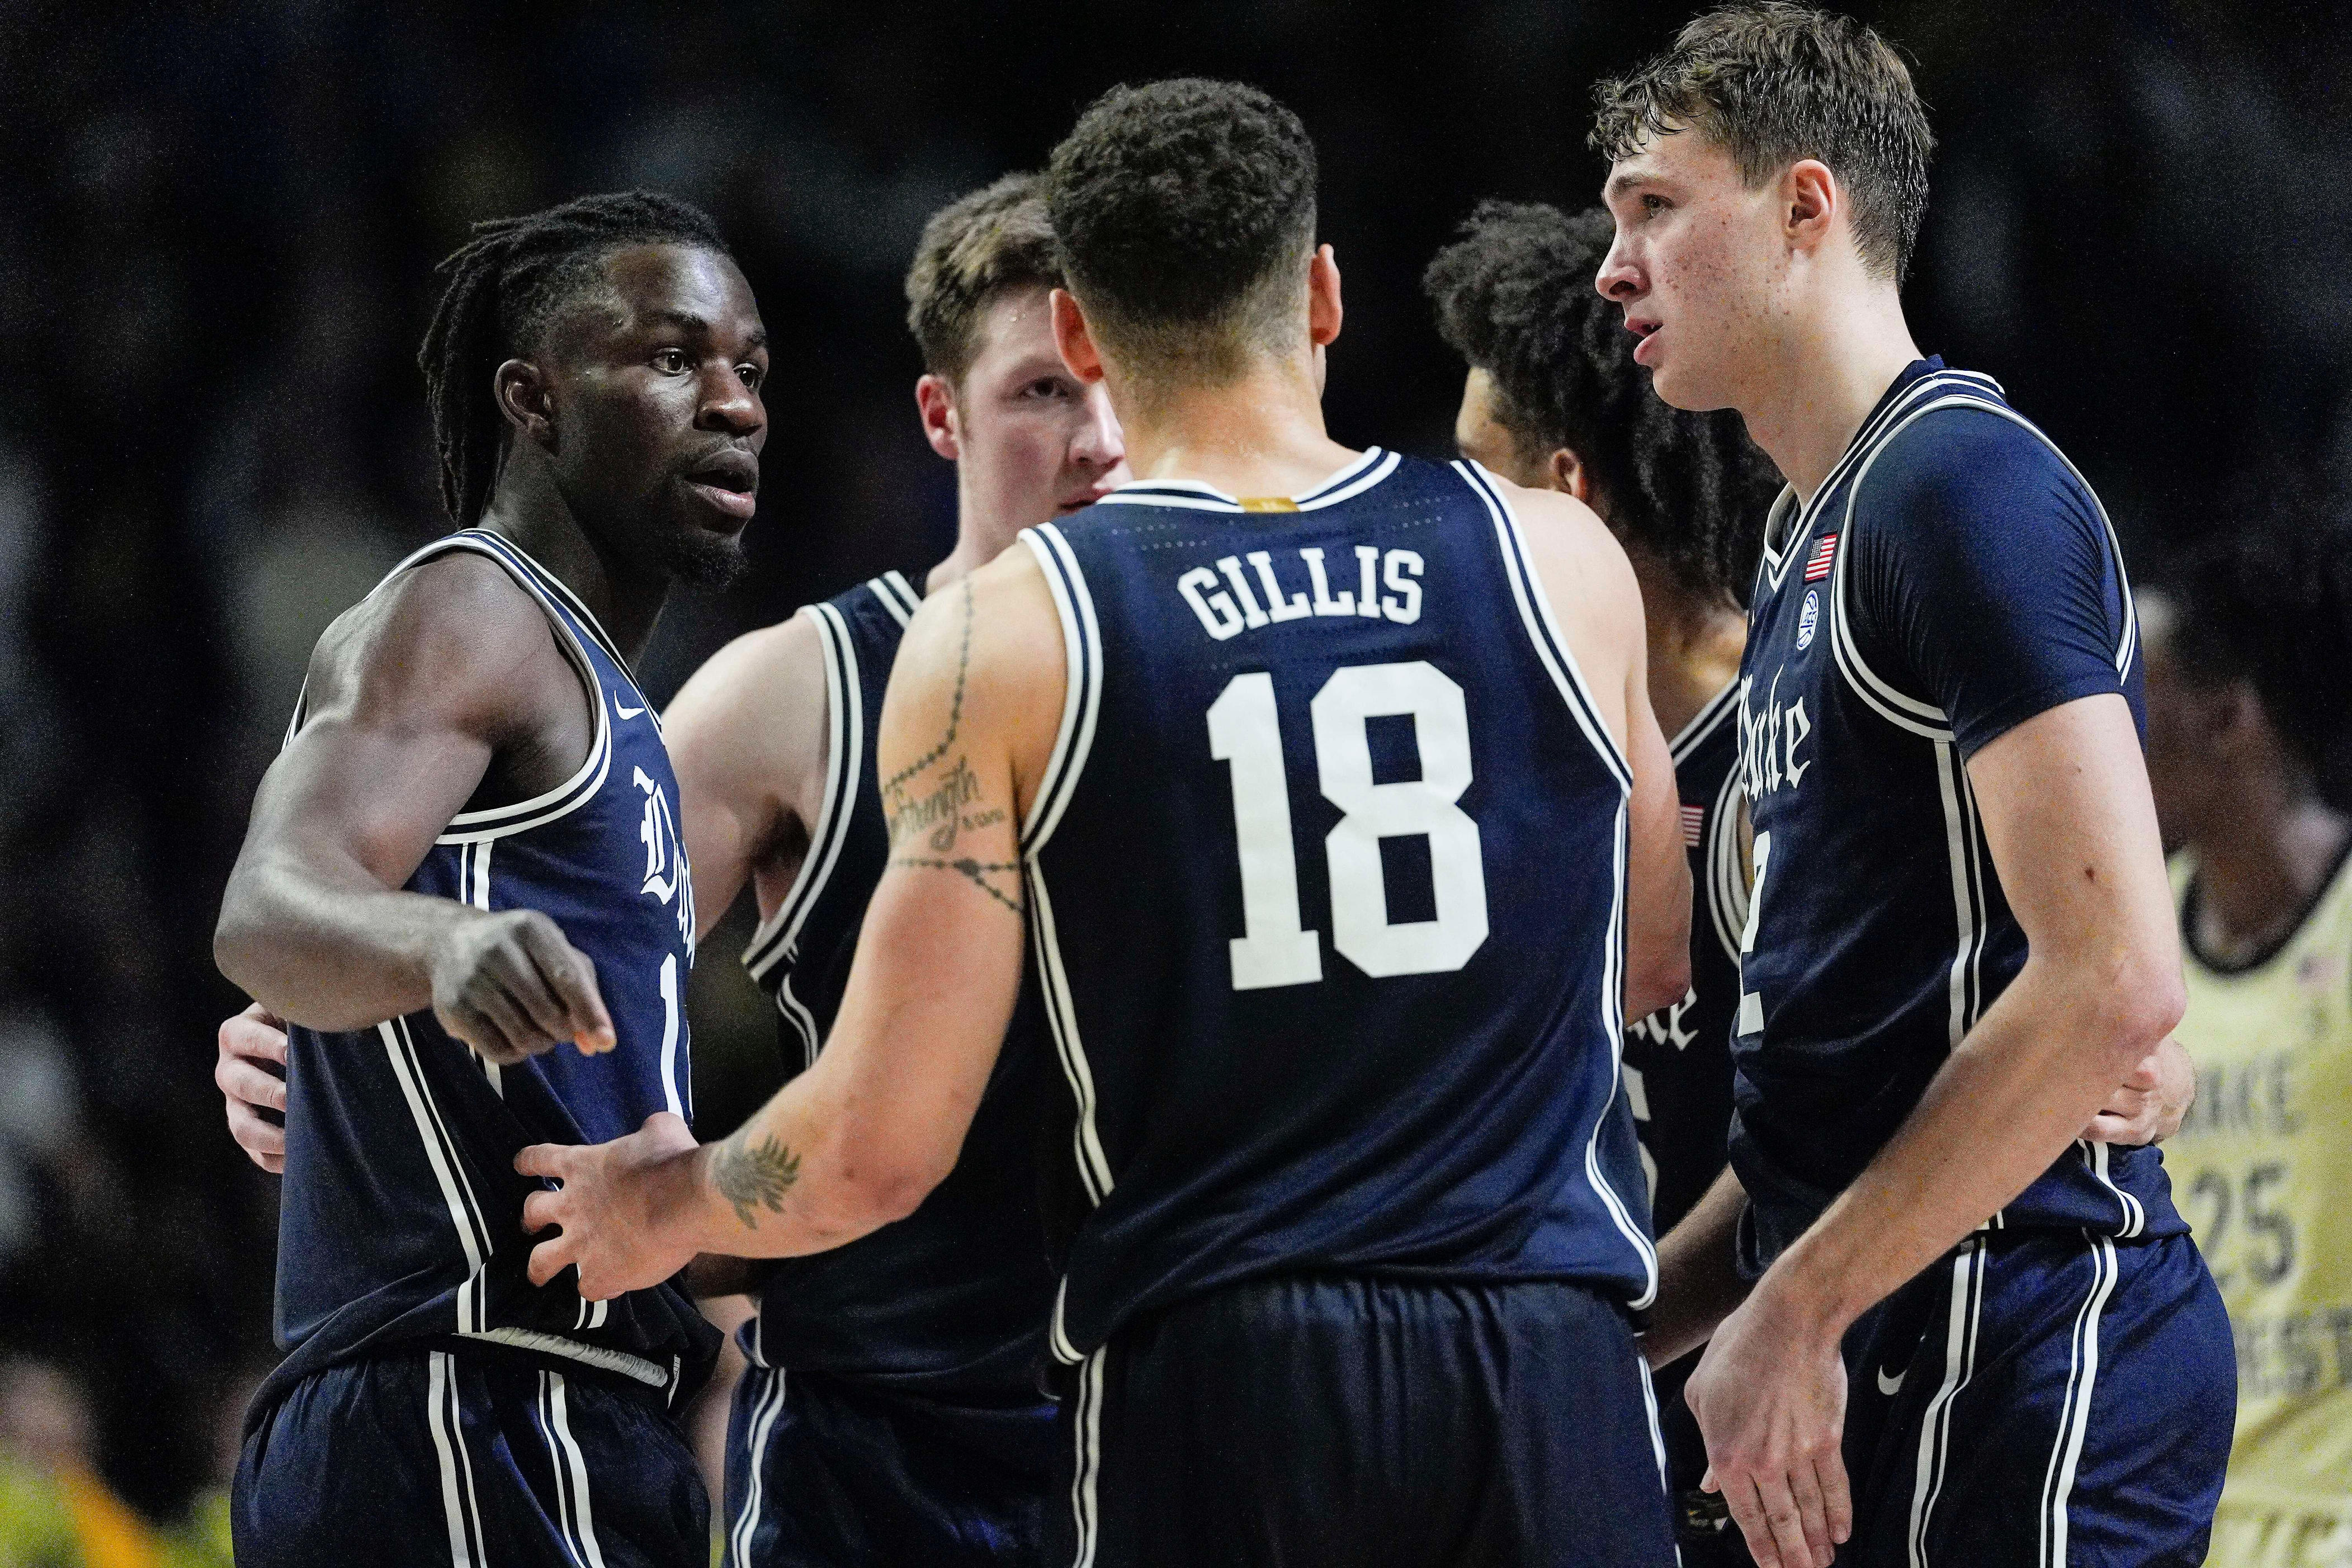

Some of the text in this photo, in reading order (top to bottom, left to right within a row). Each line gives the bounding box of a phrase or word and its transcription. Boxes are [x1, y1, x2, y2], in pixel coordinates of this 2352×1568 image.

[1178, 546, 1424, 641] GILLIS
[1206, 660, 1489, 991] 18
[660, 952, 694, 1121] 1
[2189, 1159, 2298, 1288] 25
